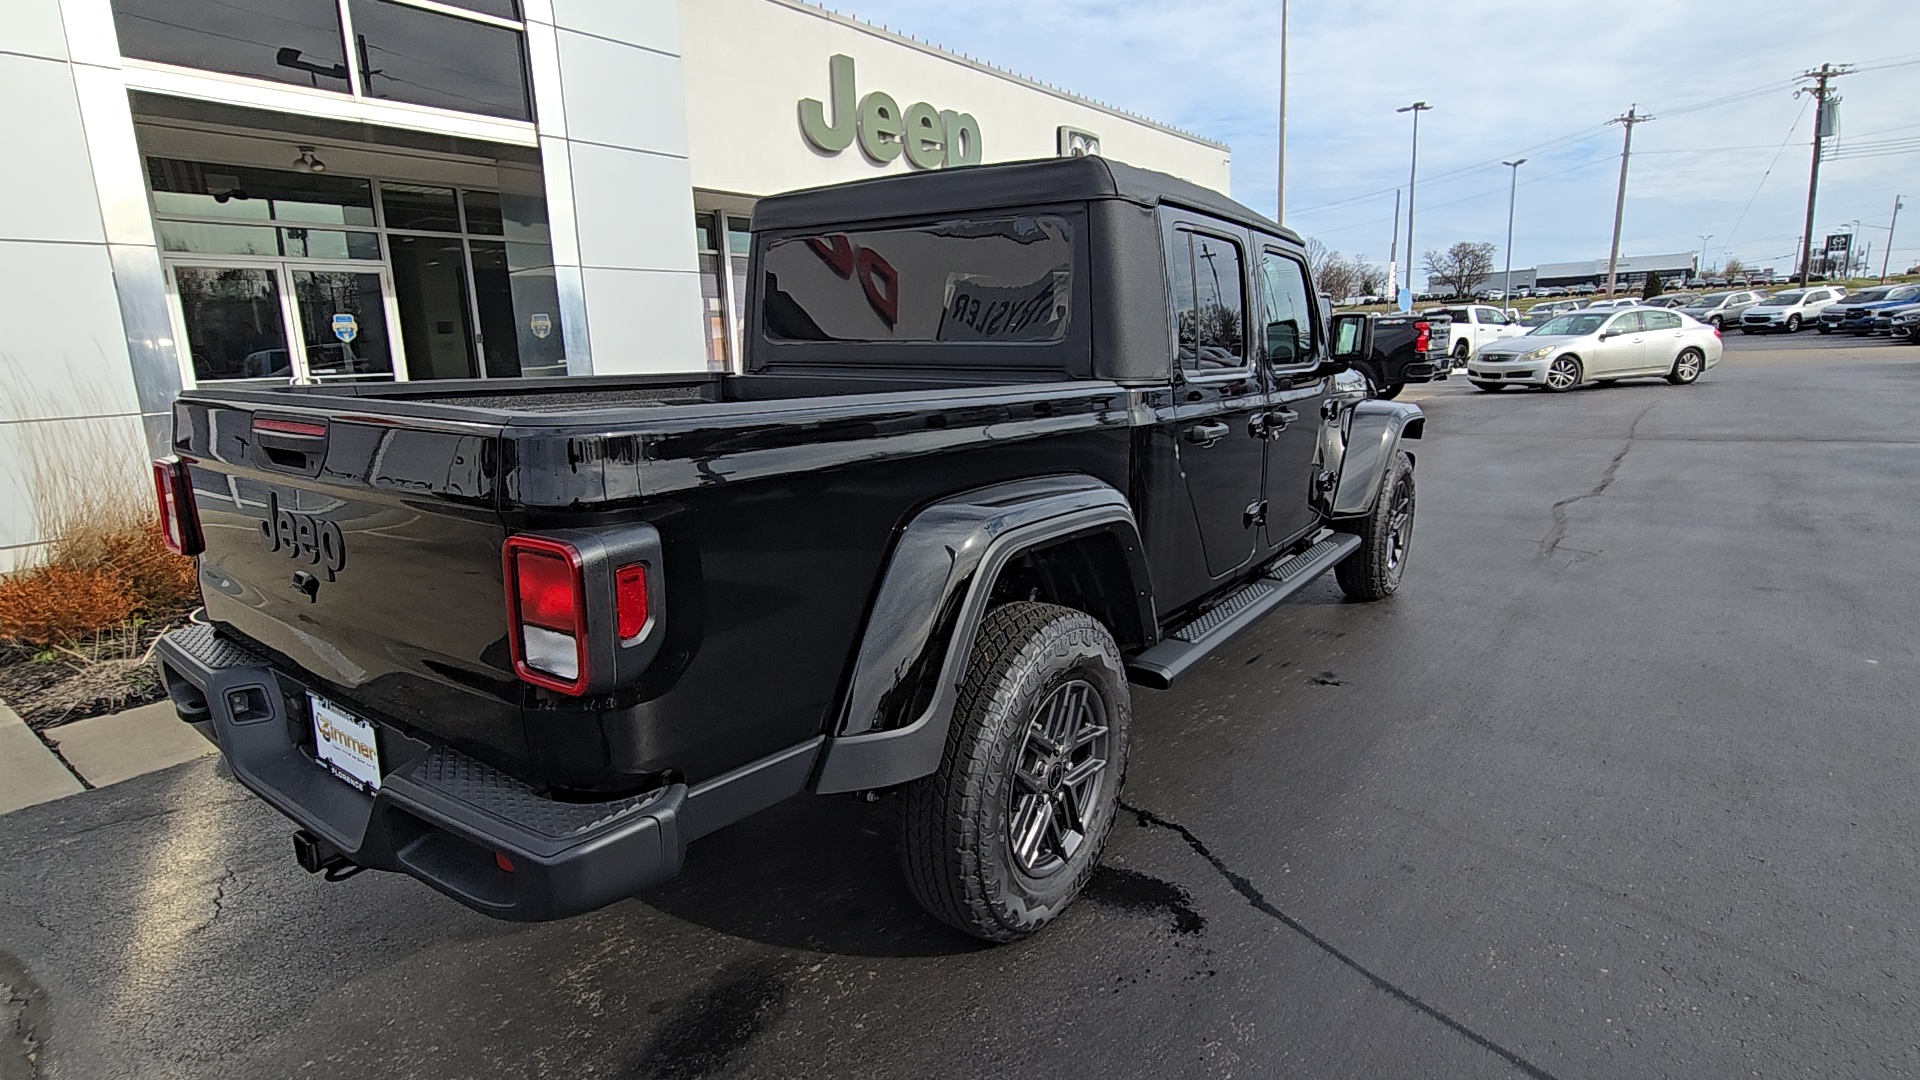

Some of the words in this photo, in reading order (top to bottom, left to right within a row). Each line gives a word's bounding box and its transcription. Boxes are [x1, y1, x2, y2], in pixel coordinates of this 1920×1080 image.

[797, 53, 982, 170] Jeep
[259, 490, 346, 583] Jeep
[317, 713, 376, 761] Zimmer
